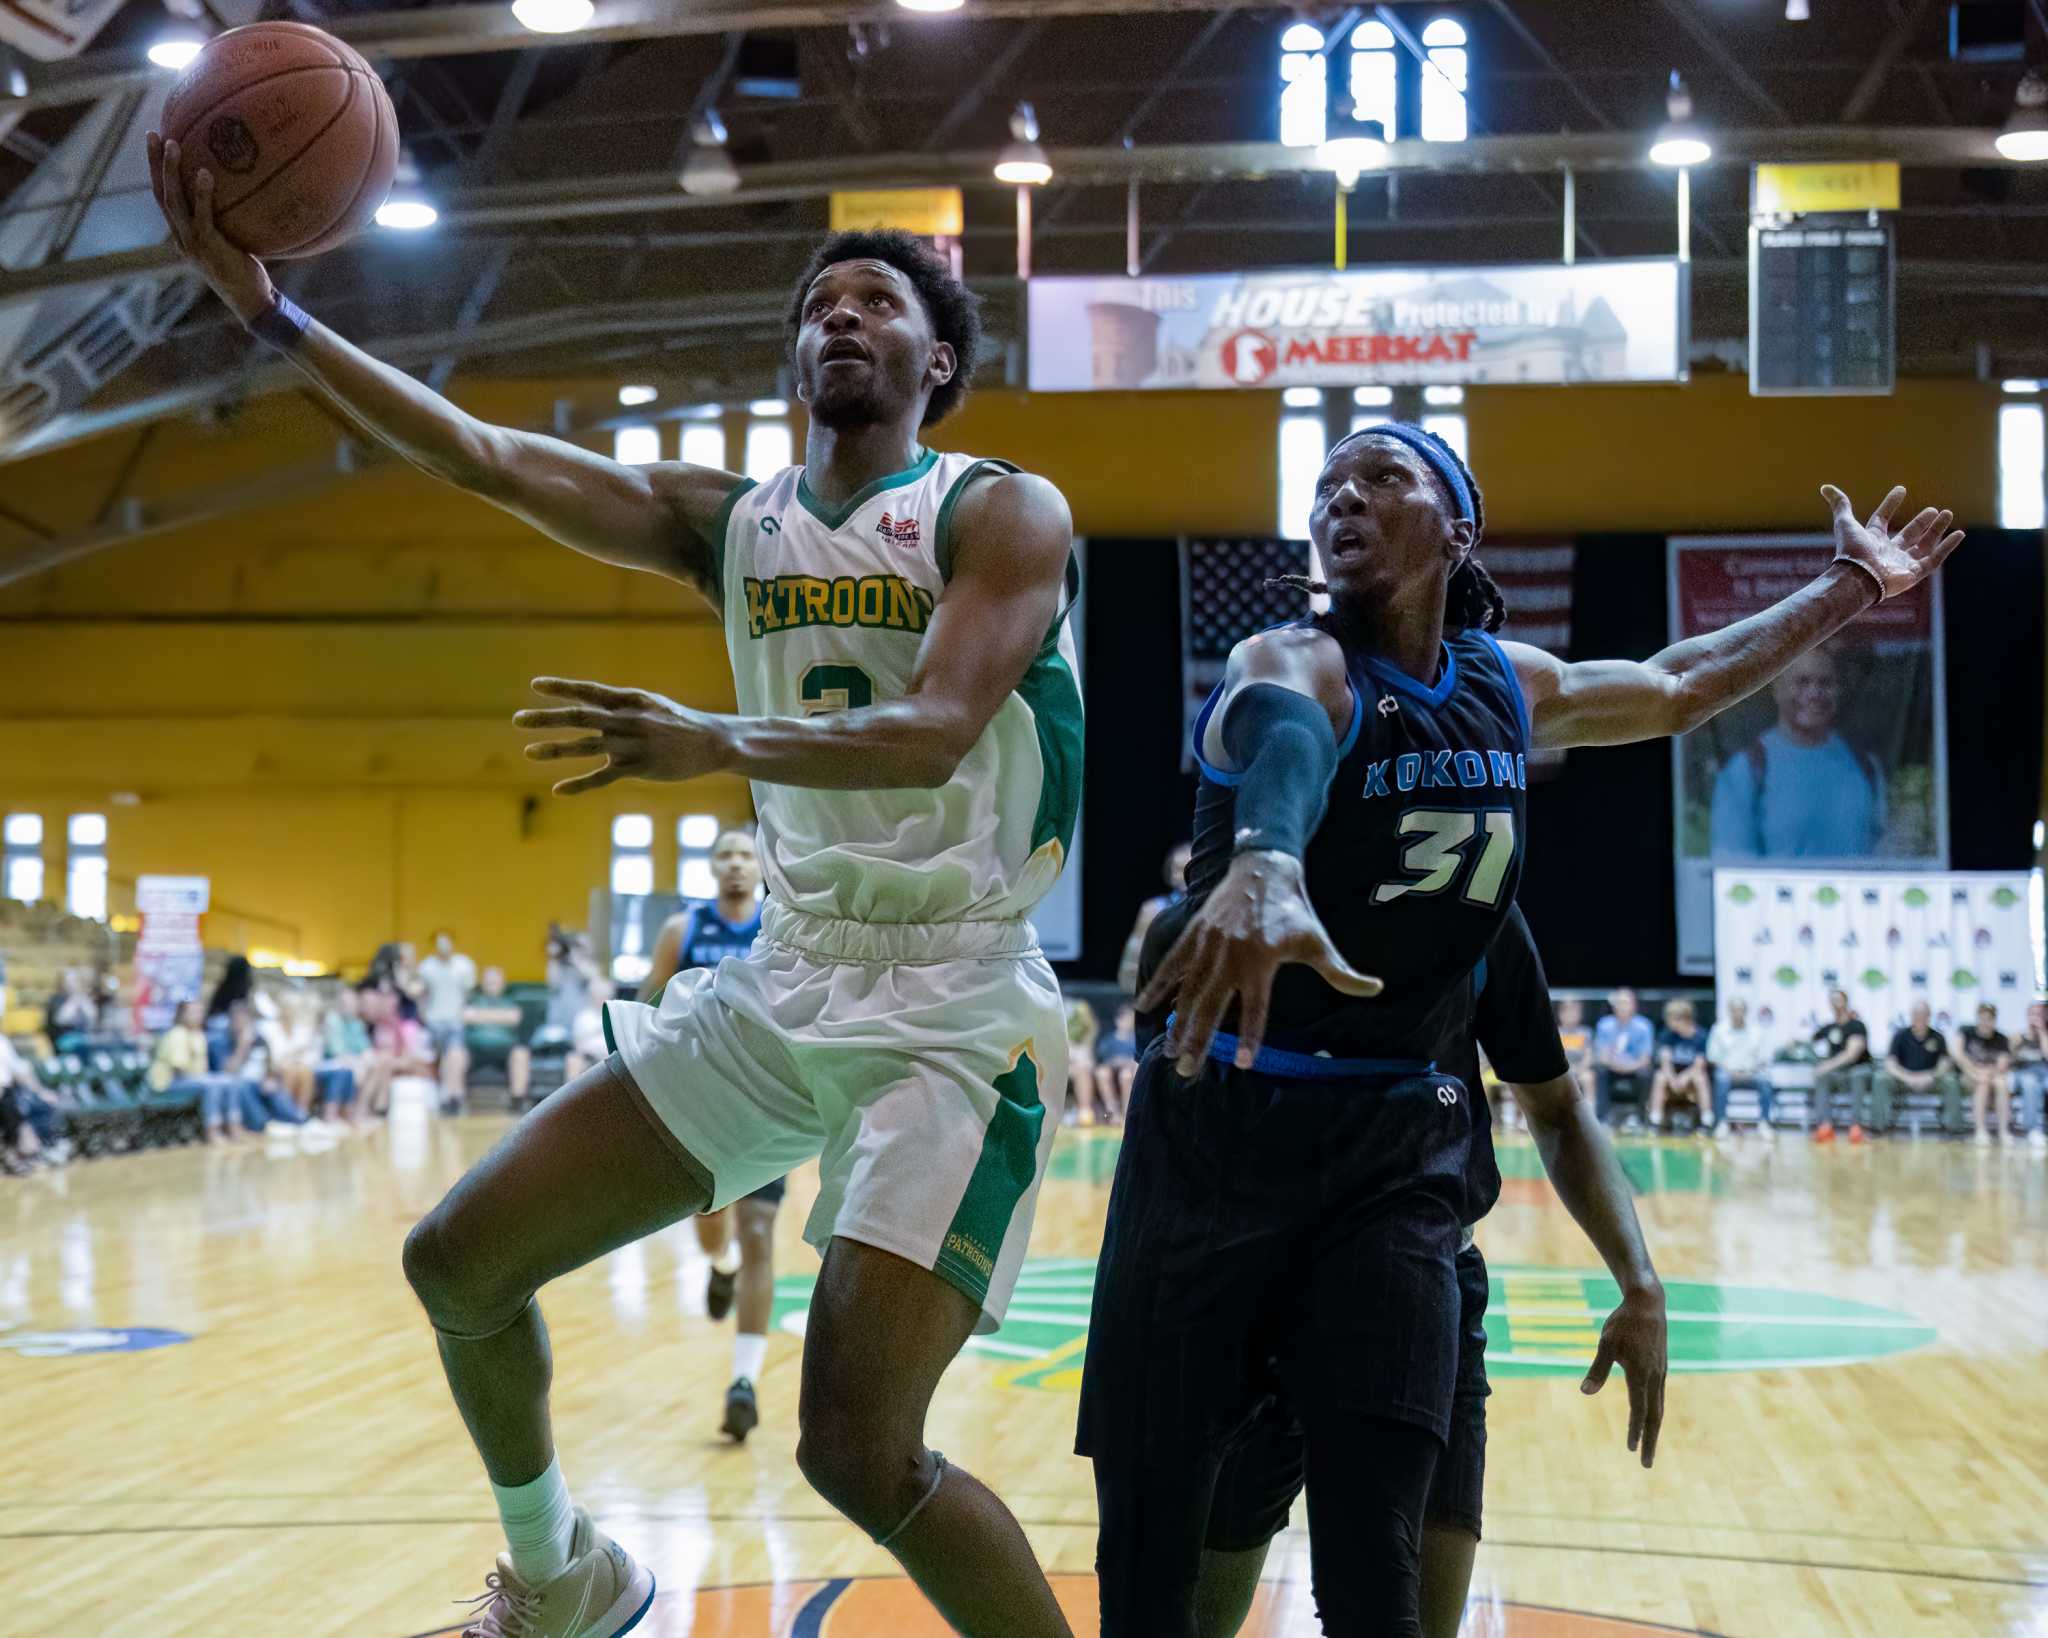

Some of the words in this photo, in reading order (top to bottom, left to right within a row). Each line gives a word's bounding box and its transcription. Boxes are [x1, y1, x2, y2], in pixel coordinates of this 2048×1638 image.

[1210, 287, 1373, 328] HOUSE
[1284, 332, 1477, 366] MEERKAT
[1369, 806, 1515, 911] 31
[947, 1232, 993, 1277] PATROONS
